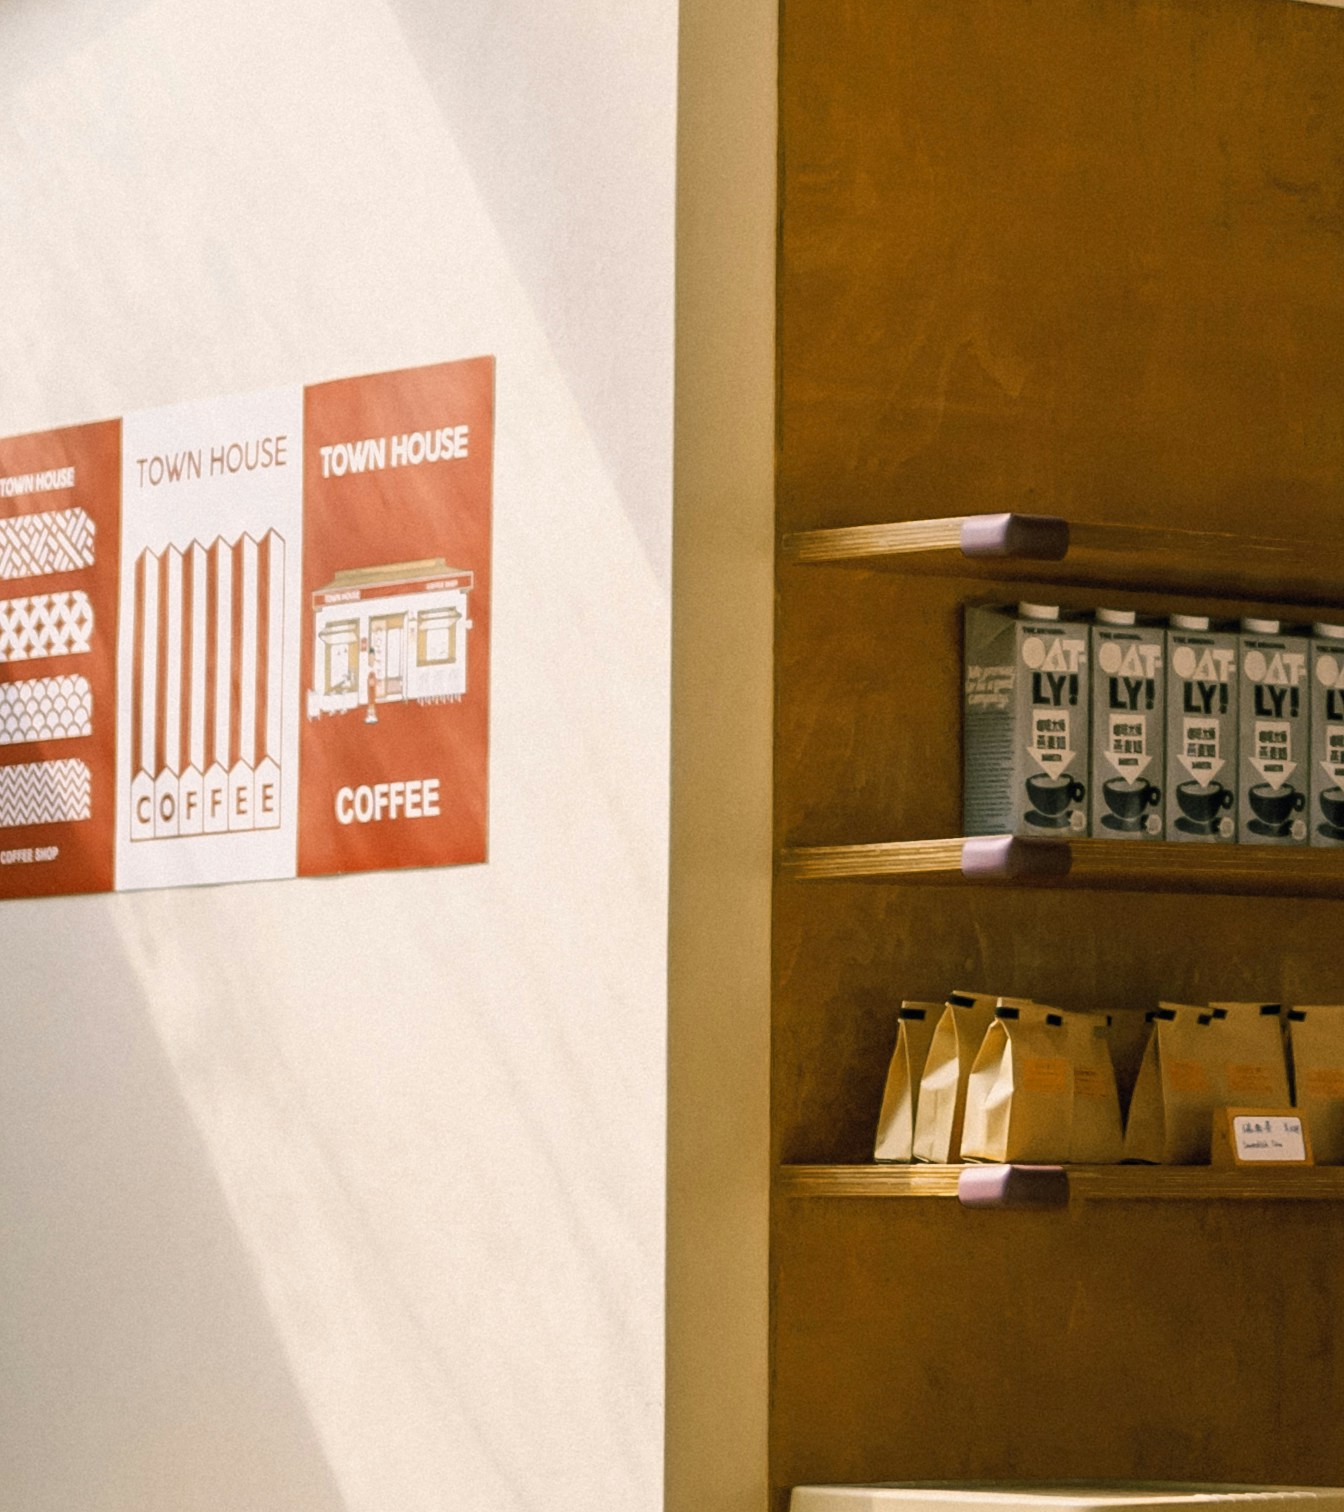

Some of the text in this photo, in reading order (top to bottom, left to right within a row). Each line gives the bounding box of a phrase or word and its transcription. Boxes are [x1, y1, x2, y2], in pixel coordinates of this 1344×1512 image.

[136, 435, 287, 488] TOWN HOUSE
[320, 425, 469, 479] TOWN HOUSE
[0, 466, 75, 497] TOWN HOUSE
[1032, 672, 1078, 706] LY!
[1109, 677, 1155, 710] LY!
[1184, 682, 1228, 714] LY!
[1255, 685, 1299, 718] LY!
[136, 783, 274, 824] COFFEE
[335, 778, 440, 825] COFFEE
